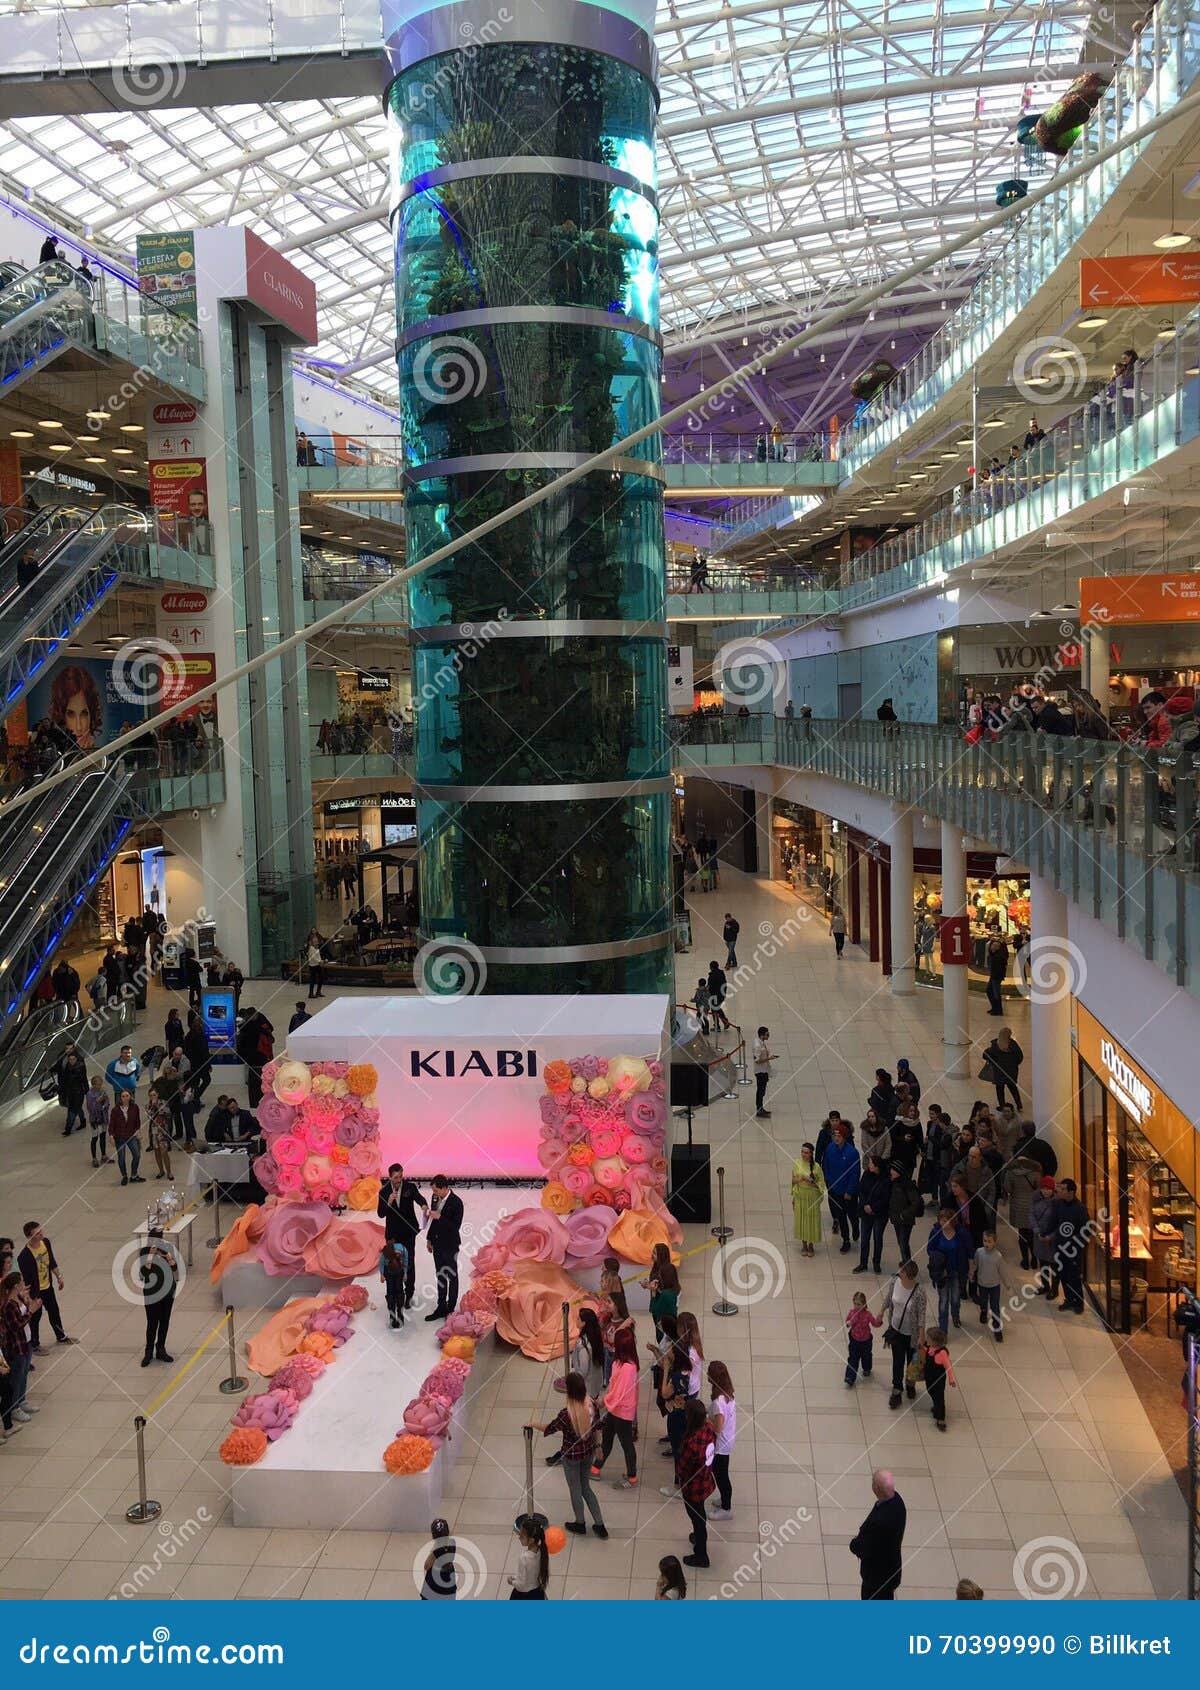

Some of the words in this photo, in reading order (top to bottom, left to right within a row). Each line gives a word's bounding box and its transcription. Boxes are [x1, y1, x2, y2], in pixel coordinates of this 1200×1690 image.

[263, 271, 304, 310] CLARINS
[163, 438, 171, 449] 4
[171, 628, 180, 639] 4
[410, 1050, 538, 1078] KIABI
